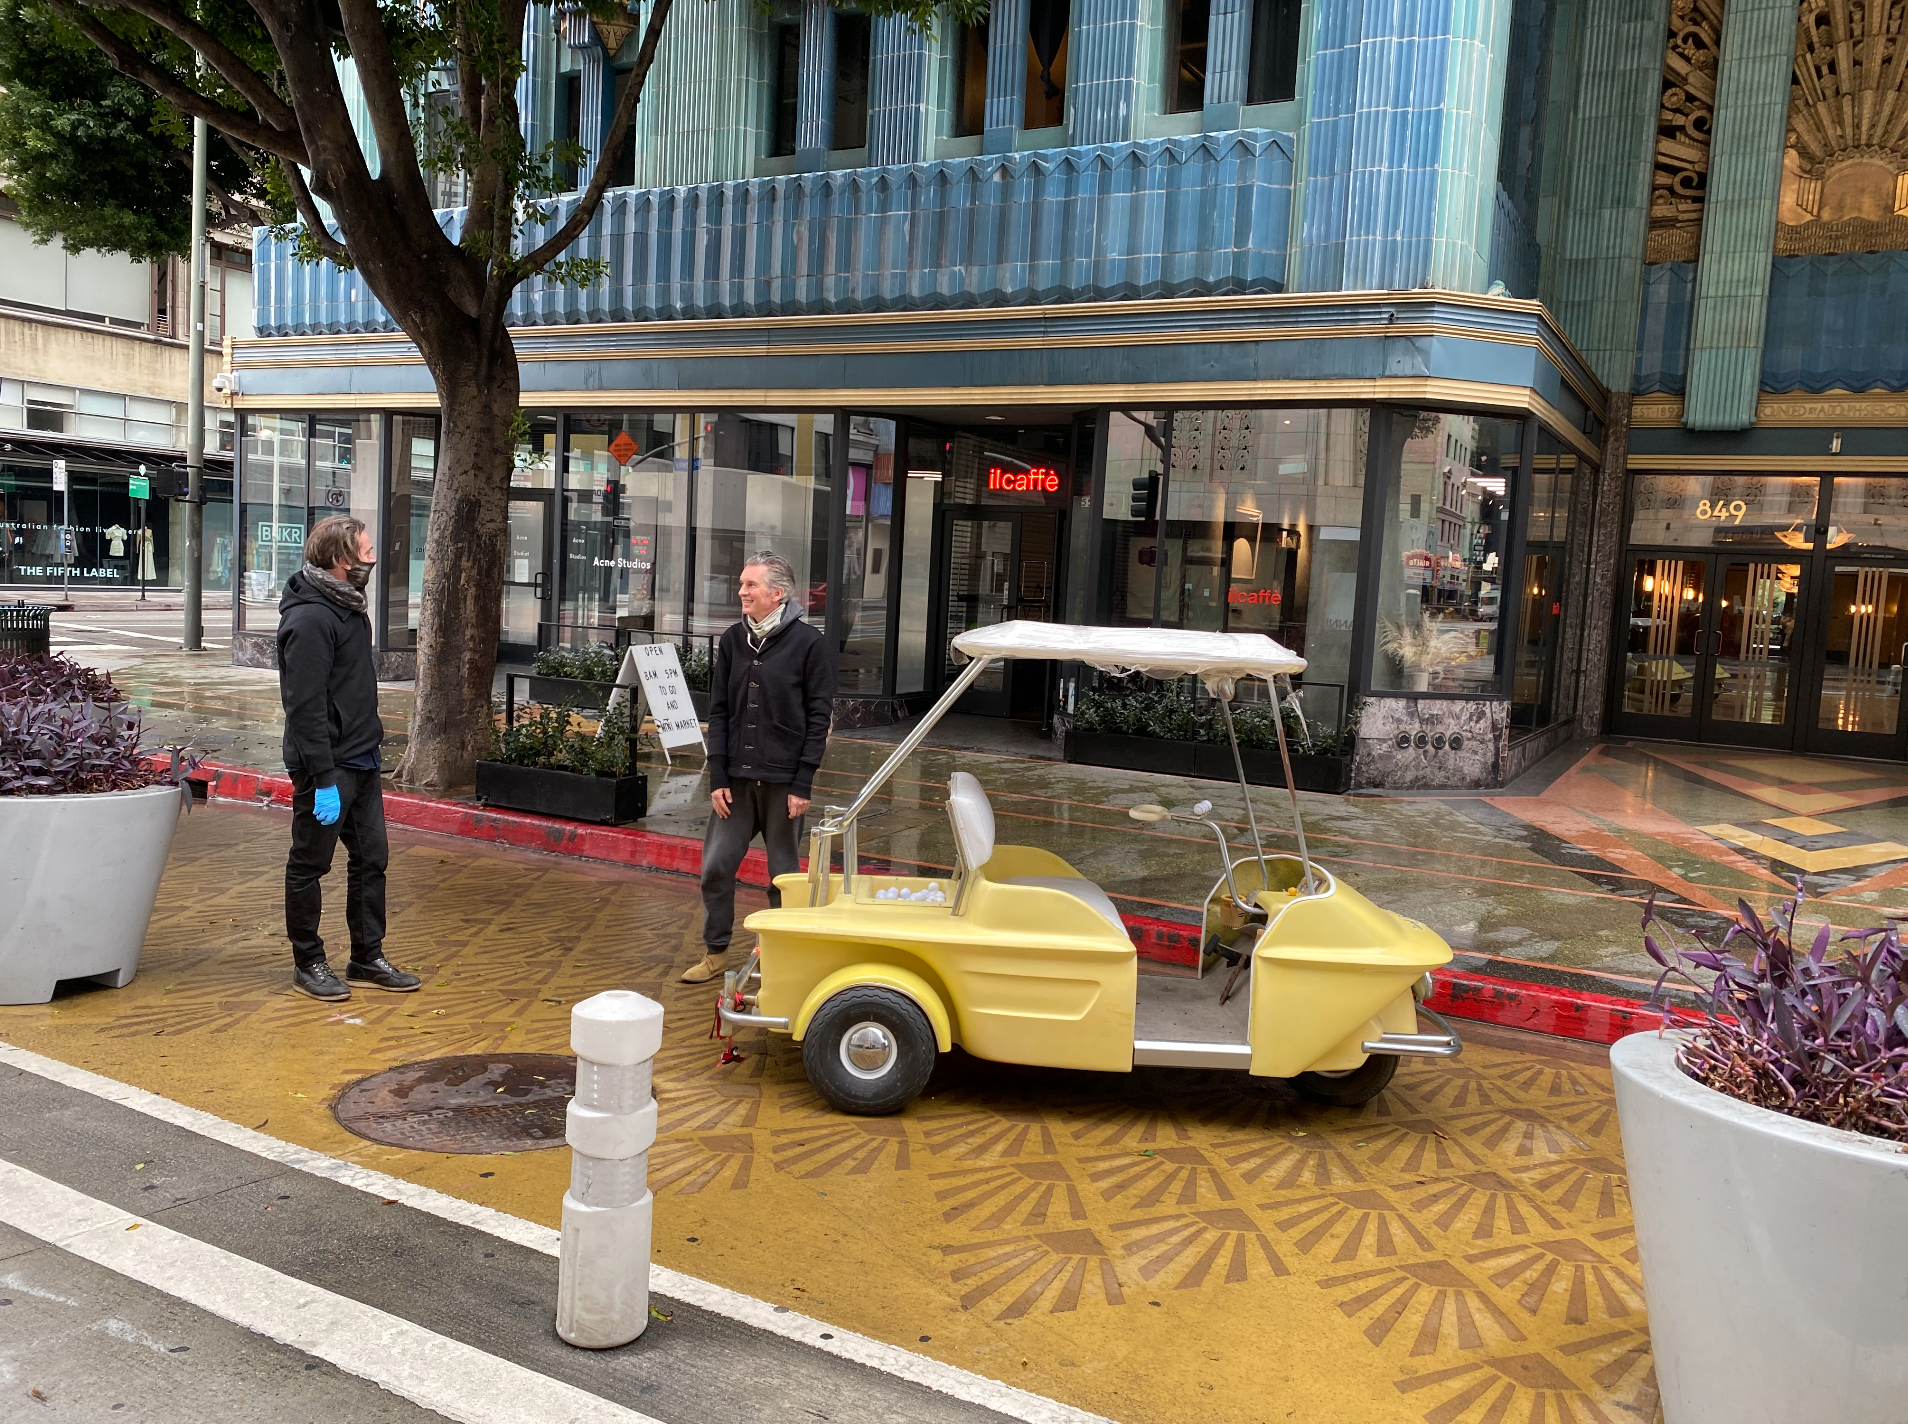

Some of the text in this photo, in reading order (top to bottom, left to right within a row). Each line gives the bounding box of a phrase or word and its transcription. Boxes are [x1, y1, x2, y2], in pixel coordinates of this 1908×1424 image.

[988, 467, 1059, 492] ilcaffè
[1696, 499, 1747, 525] 849
[0, 522, 48, 530] ustralian
[53, 523, 91, 532] fhion
[592, 556, 651, 569] Acne Studios
[19, 566, 119, 578] THE FIFTH LABEL
[1227, 588, 1282, 605] ilcaffè
[644, 646, 664, 656] OPEN
[664, 668, 679, 679] 5PM
[658, 685, 677, 695] TO GO
[666, 699, 679, 711] AND
